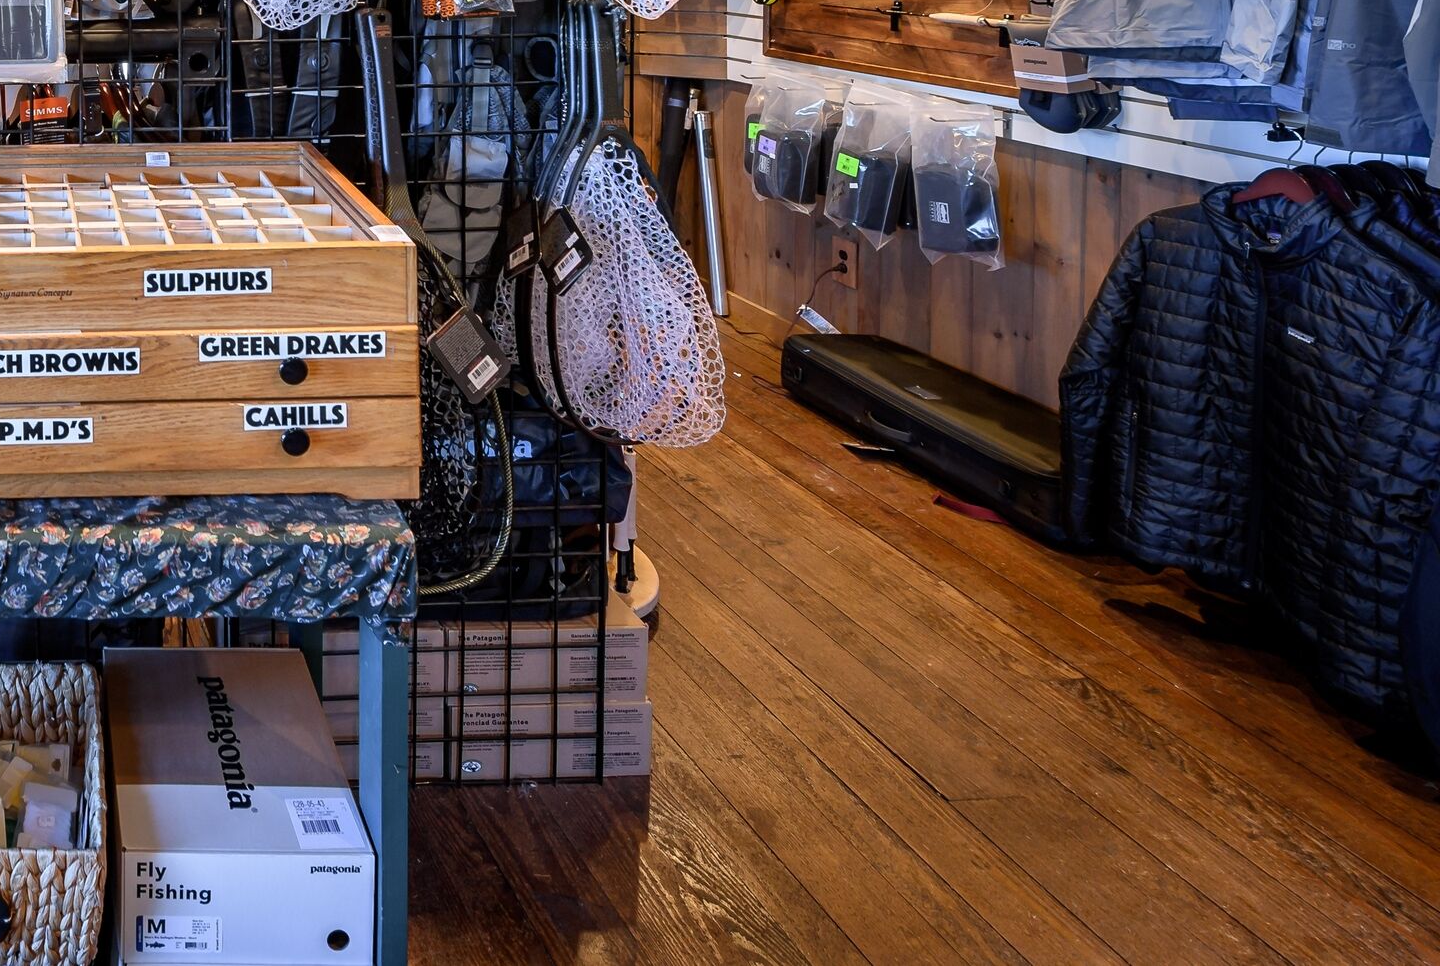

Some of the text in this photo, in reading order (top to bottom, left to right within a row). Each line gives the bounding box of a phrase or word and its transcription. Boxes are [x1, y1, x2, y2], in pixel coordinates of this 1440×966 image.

[146, 271, 269, 292] SULPHURS
[37, 287, 73, 298] Concepts
[200, 334, 383, 357] GREEN DRAKES
[30, 351, 139, 373] BROWNS
[245, 404, 345, 427] CAHILLS
[197, 676, 255, 810] patagonia
[137, 862, 167, 882] Fly
[310, 865, 360, 874] patagonia
[136, 884, 212, 905] Fishing
[148, 919, 166, 933] M
